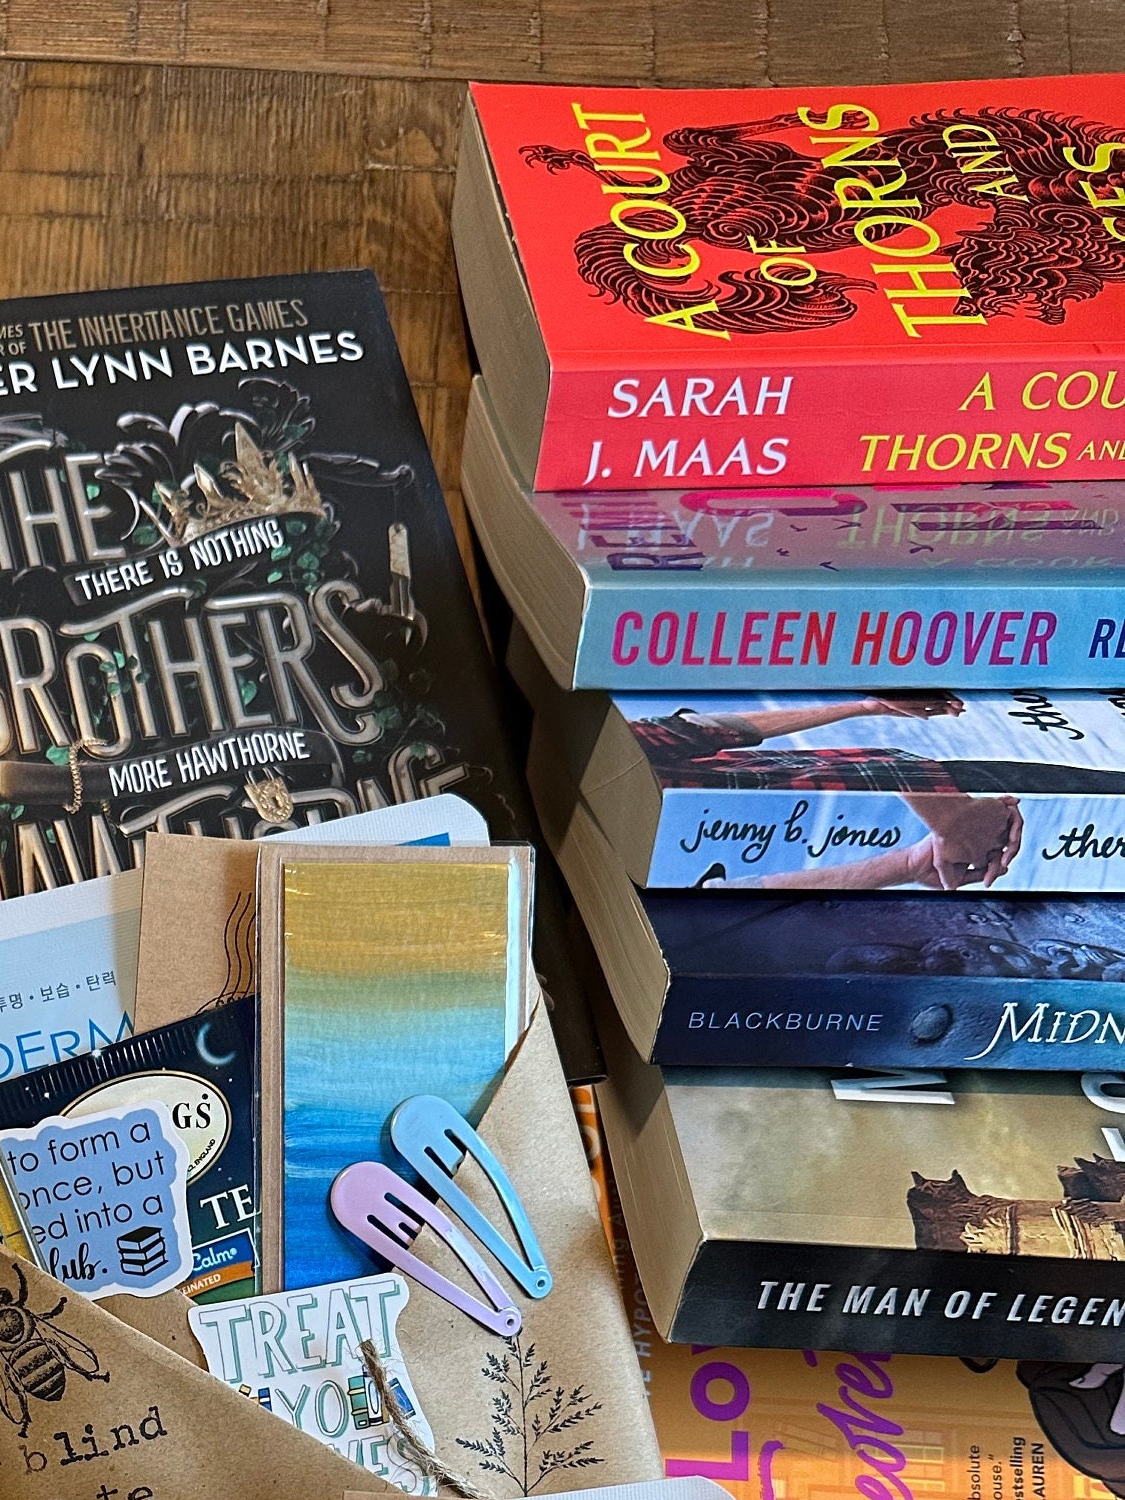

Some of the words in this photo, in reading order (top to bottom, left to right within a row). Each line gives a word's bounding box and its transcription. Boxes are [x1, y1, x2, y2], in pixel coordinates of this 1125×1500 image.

[944, 123, 1031, 203] AND
[571, 102, 702, 279] COURT
[798, 102, 989, 339] THORNS
[750, 235, 818, 288] OF
[28, 318, 77, 353] THE
[77, 304, 224, 347] INHERITANCE
[226, 298, 309, 334] GAMES
[644, 299, 732, 341] A
[8, 341, 27, 356] OF
[50, 346, 174, 391] LYNN
[186, 329, 365, 377] BARNES
[607, 376, 793, 418] SARAH
[958, 371, 996, 411] A
[1021, 371, 1125, 411] COU
[583, 441, 612, 486] J.
[633, 437, 789, 478] MAAS
[859, 431, 1072, 472] THORNS
[75, 561, 155, 601] THERE
[161, 549, 184, 578] IS
[191, 519, 286, 572] NOTHING
[611, 610, 836, 667] COLLEEN
[850, 610, 1059, 667] HOOVER
[108, 751, 174, 798] MORE
[175, 730, 312, 784] HAWTHORNE
[680, 808, 777, 864] jenny
[783, 800, 810, 845] b.
[806, 814, 902, 858] jones
[1041, 823, 1125, 860] ther
[40, 981, 71, 1003] 보습
[85, 969, 118, 992] 탄력
[688, 1011, 884, 1034] BLACKBURNE
[963, 1001, 1125, 1062] MIDN
[7, 1151, 39, 1176] to
[48, 1122, 122, 1166] form
[129, 1119, 152, 1143] a
[193, 1137, 217, 1166] ENGLAND
[18, 1177, 104, 1211] once,
[112, 1150, 165, 1187] but
[200, 1183, 262, 1231] TE
[75, 1202, 133, 1234] into
[142, 1193, 164, 1216] a
[49, 1242, 109, 1283] lub.
[178, 1273, 222, 1296] EINATED
[757, 1281, 831, 1312] THE
[842, 1285, 931, 1317] MAN
[944, 1290, 998, 1320] OF
[198, 1279, 401, 1384] TREAT
[18, 1405, 168, 1475] blind
[665, 1345, 750, 1482] LO
